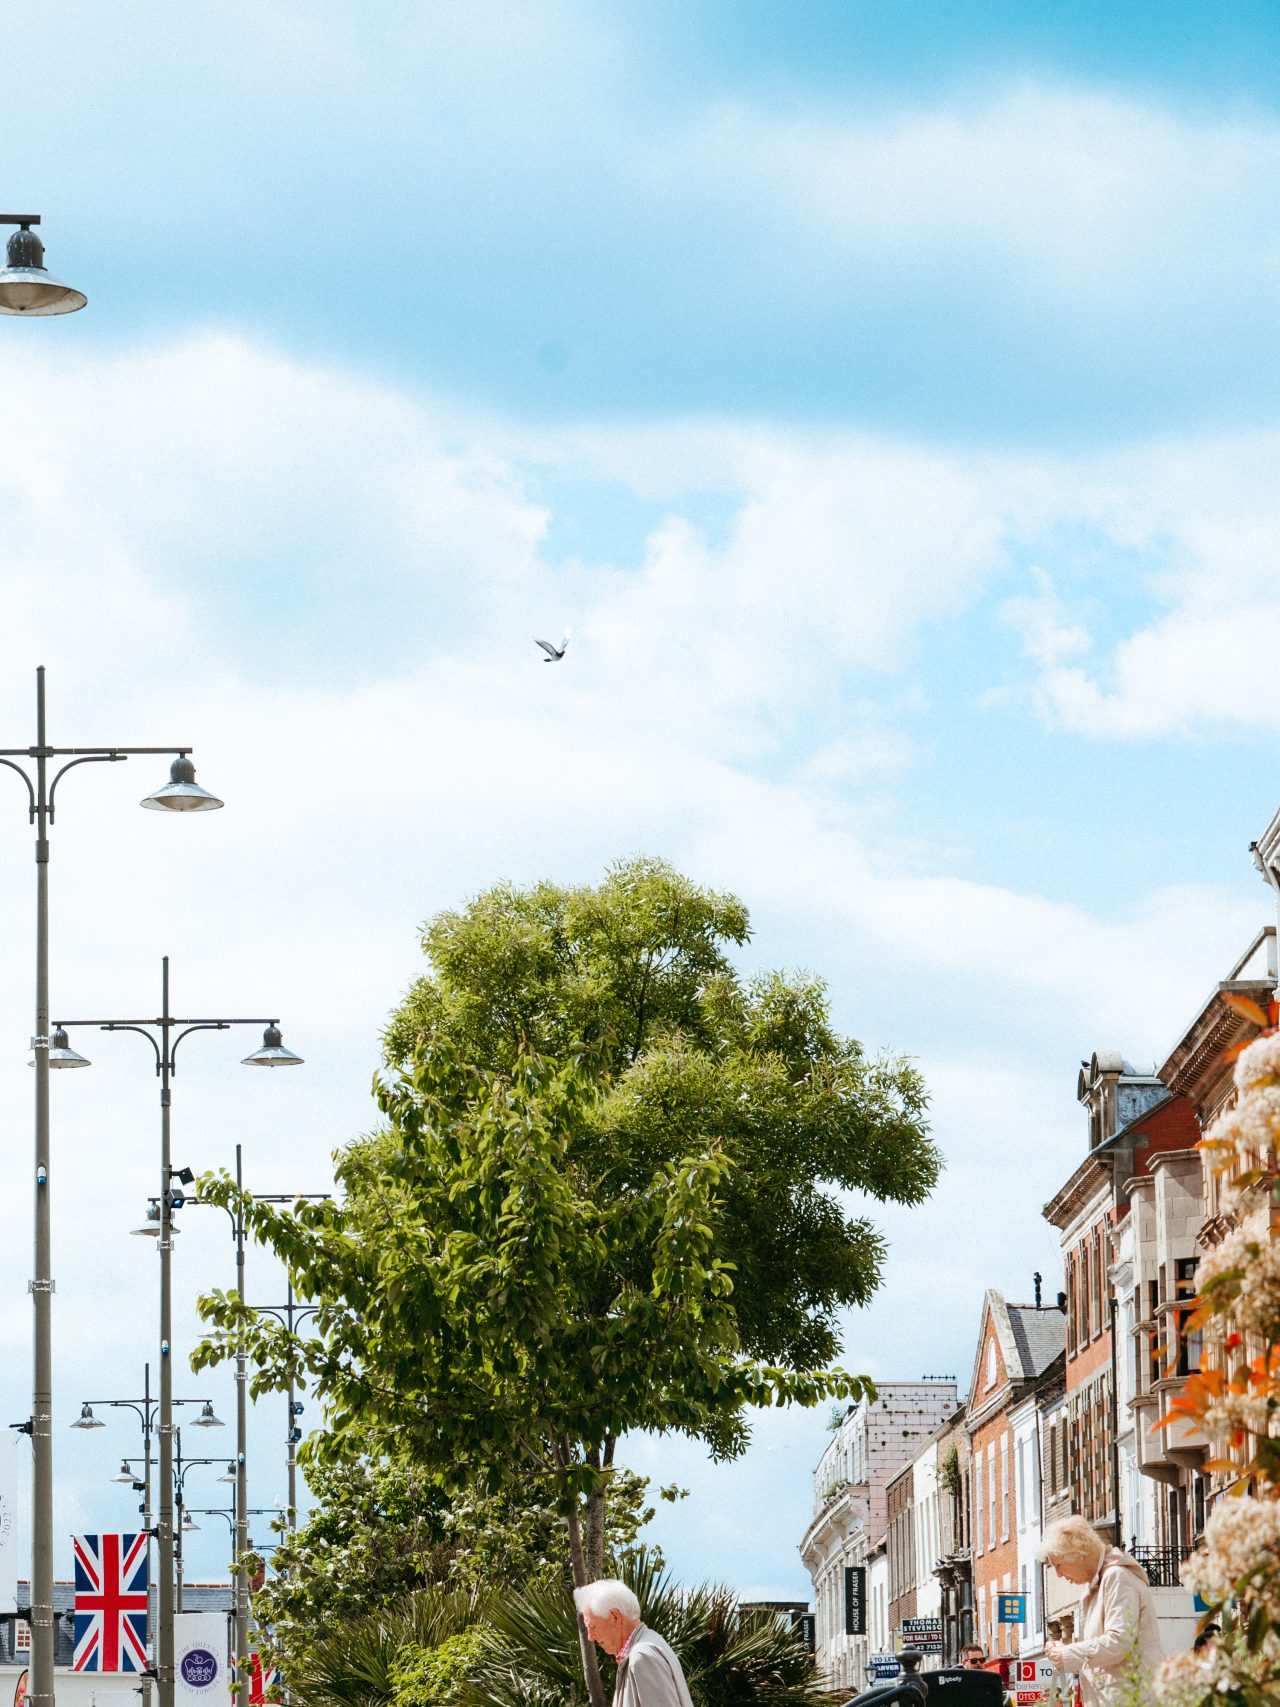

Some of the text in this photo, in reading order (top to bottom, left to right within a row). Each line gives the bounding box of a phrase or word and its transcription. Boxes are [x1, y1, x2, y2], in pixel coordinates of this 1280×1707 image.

[2, 1512, 12, 1536] 2022
[853, 1597, 859, 1606] OF
[1040, 1668, 1052, 1676] TO
[1018, 1692, 1035, 1701] 0113
